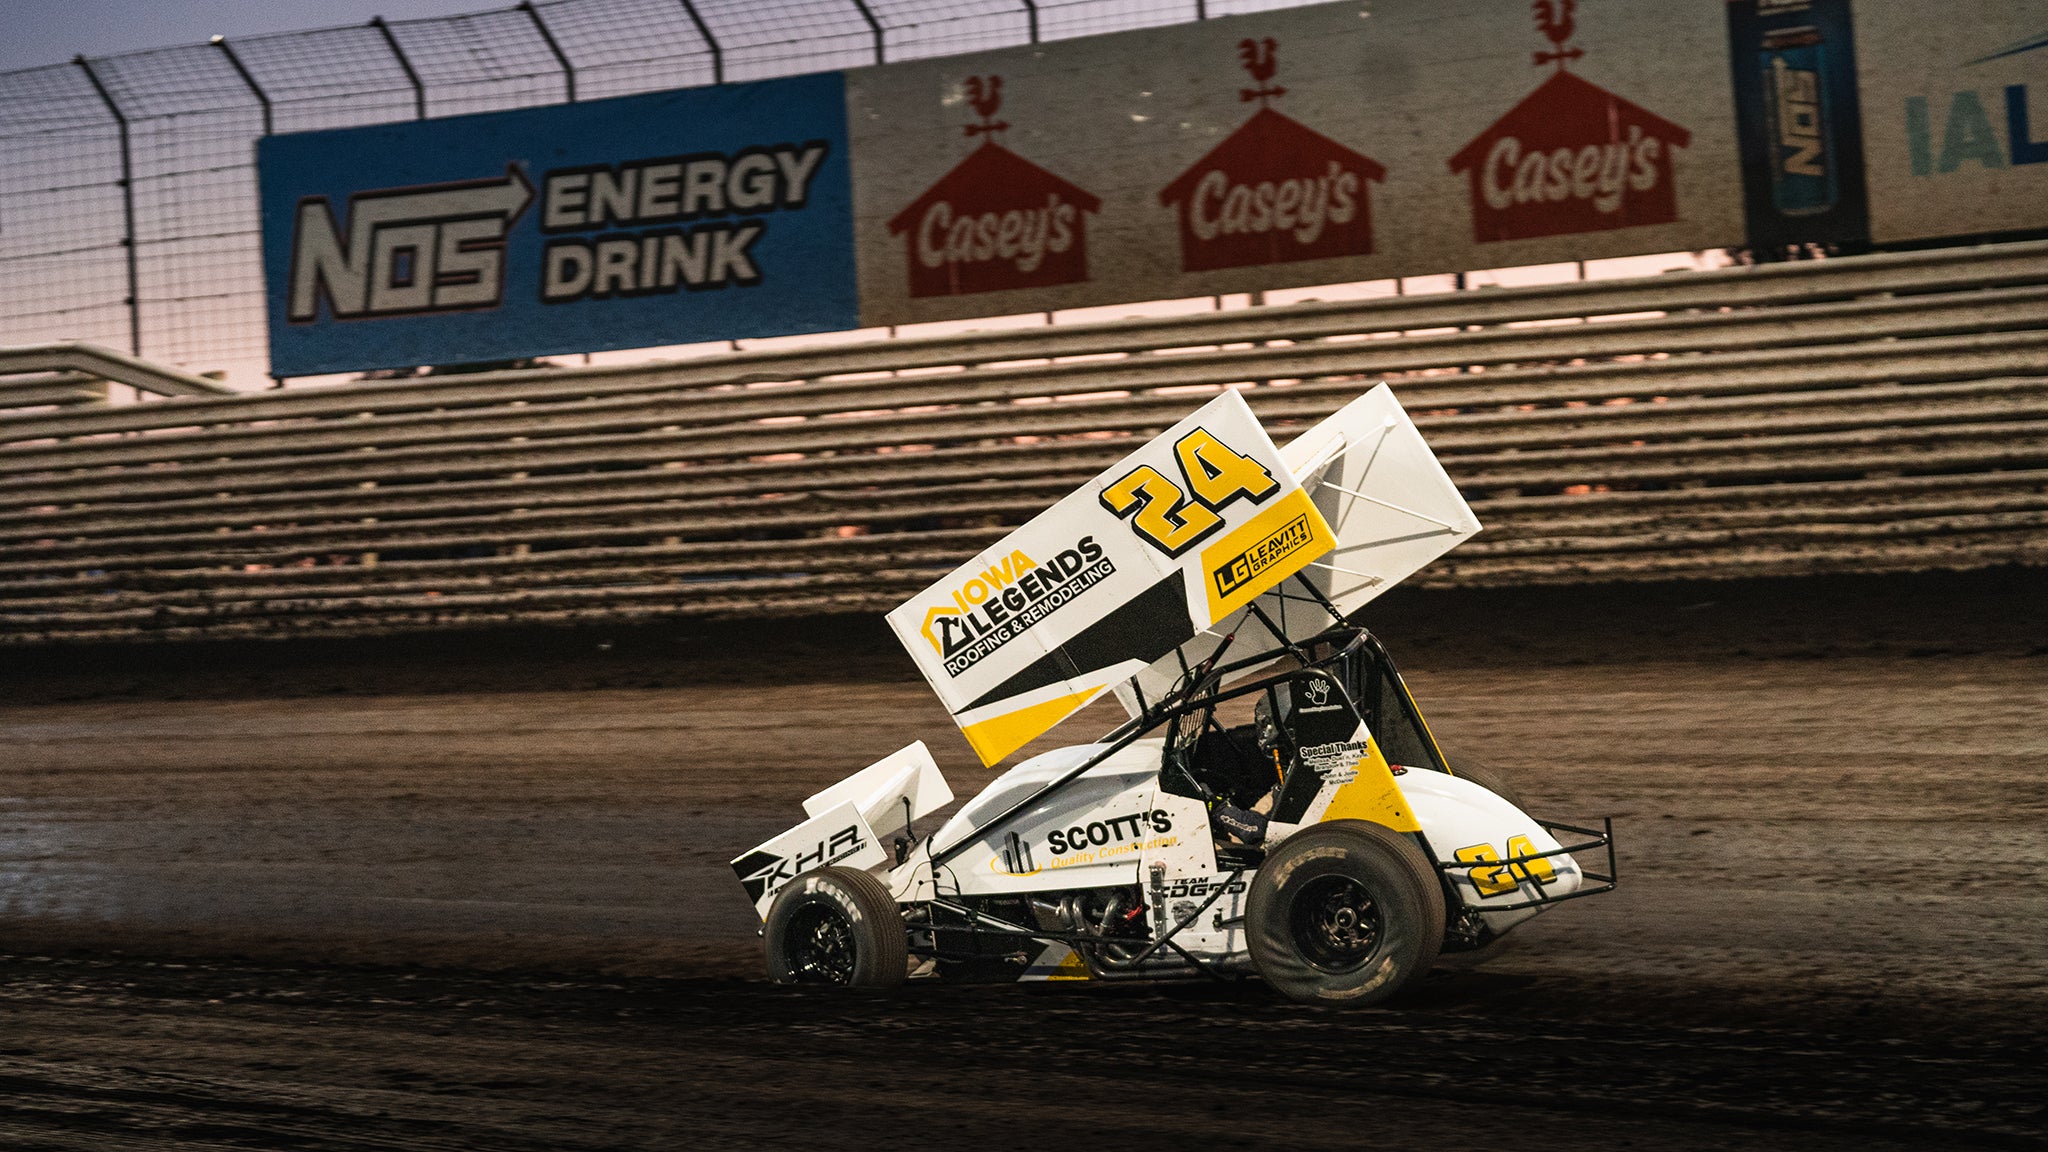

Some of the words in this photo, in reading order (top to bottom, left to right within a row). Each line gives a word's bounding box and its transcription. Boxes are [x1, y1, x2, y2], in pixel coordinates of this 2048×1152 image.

[542, 141, 828, 231] ENERGY
[1192, 162, 1359, 243] Casey's
[1481, 126, 1661, 212] Casey's
[288, 162, 535, 322] NOS
[541, 221, 764, 302] DRINK
[919, 193, 1075, 271] Casey's
[1099, 426, 1281, 560] 24
[1216, 557, 1250, 594] LG
[1249, 520, 1305, 563] LEAVITT
[1253, 532, 1307, 571] GRAPHICS
[952, 549, 1037, 612] IOWA
[967, 535, 1103, 636] LEGENDS
[948, 628, 1011, 676] ROOFING
[1013, 620, 1024, 633] &
[1023, 560, 1113, 626] REMODELING
[1301, 745, 1334, 758] Special
[1335, 741, 1368, 752] Thanks
[1047, 809, 1172, 855] SCOTT'S
[1051, 852, 1095, 869] Quality
[1454, 834, 1558, 899] 24
[1174, 877, 1209, 885] TEAM
